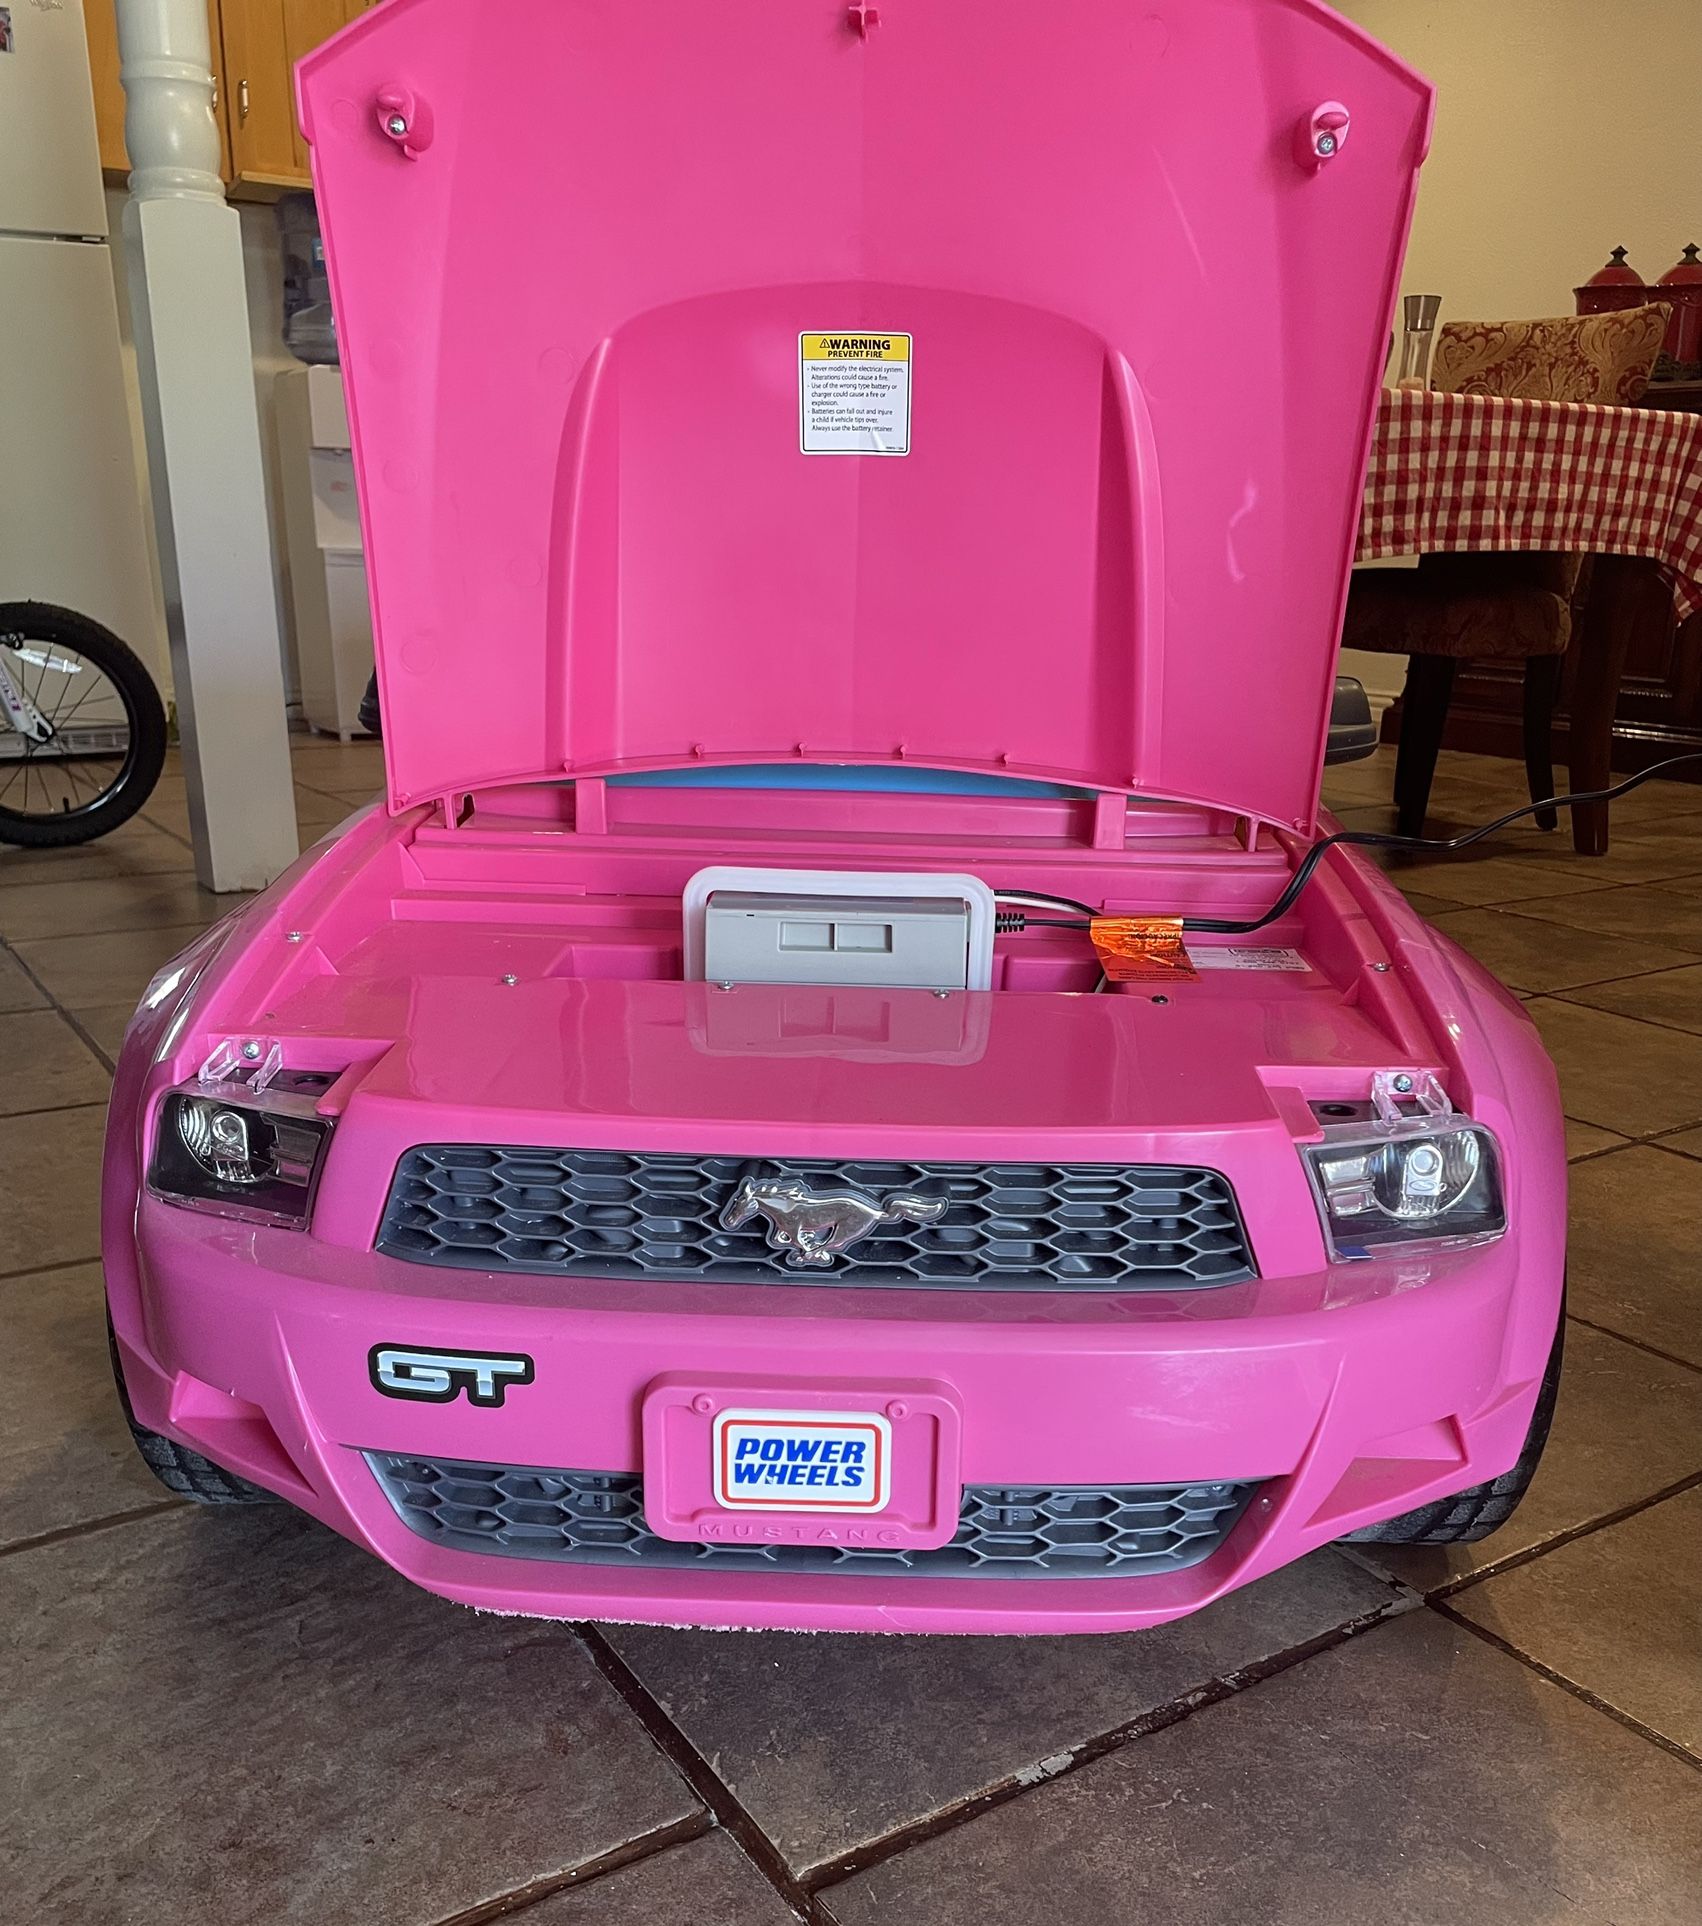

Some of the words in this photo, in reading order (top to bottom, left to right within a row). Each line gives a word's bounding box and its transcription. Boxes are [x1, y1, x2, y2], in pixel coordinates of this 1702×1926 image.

[830, 339, 891, 350] WARNING
[375, 1349, 527, 1400] GT
[735, 1437, 867, 1464] POWER
[734, 1463, 866, 1487] WHEELS
[698, 1523, 901, 1543] MUSTANG
